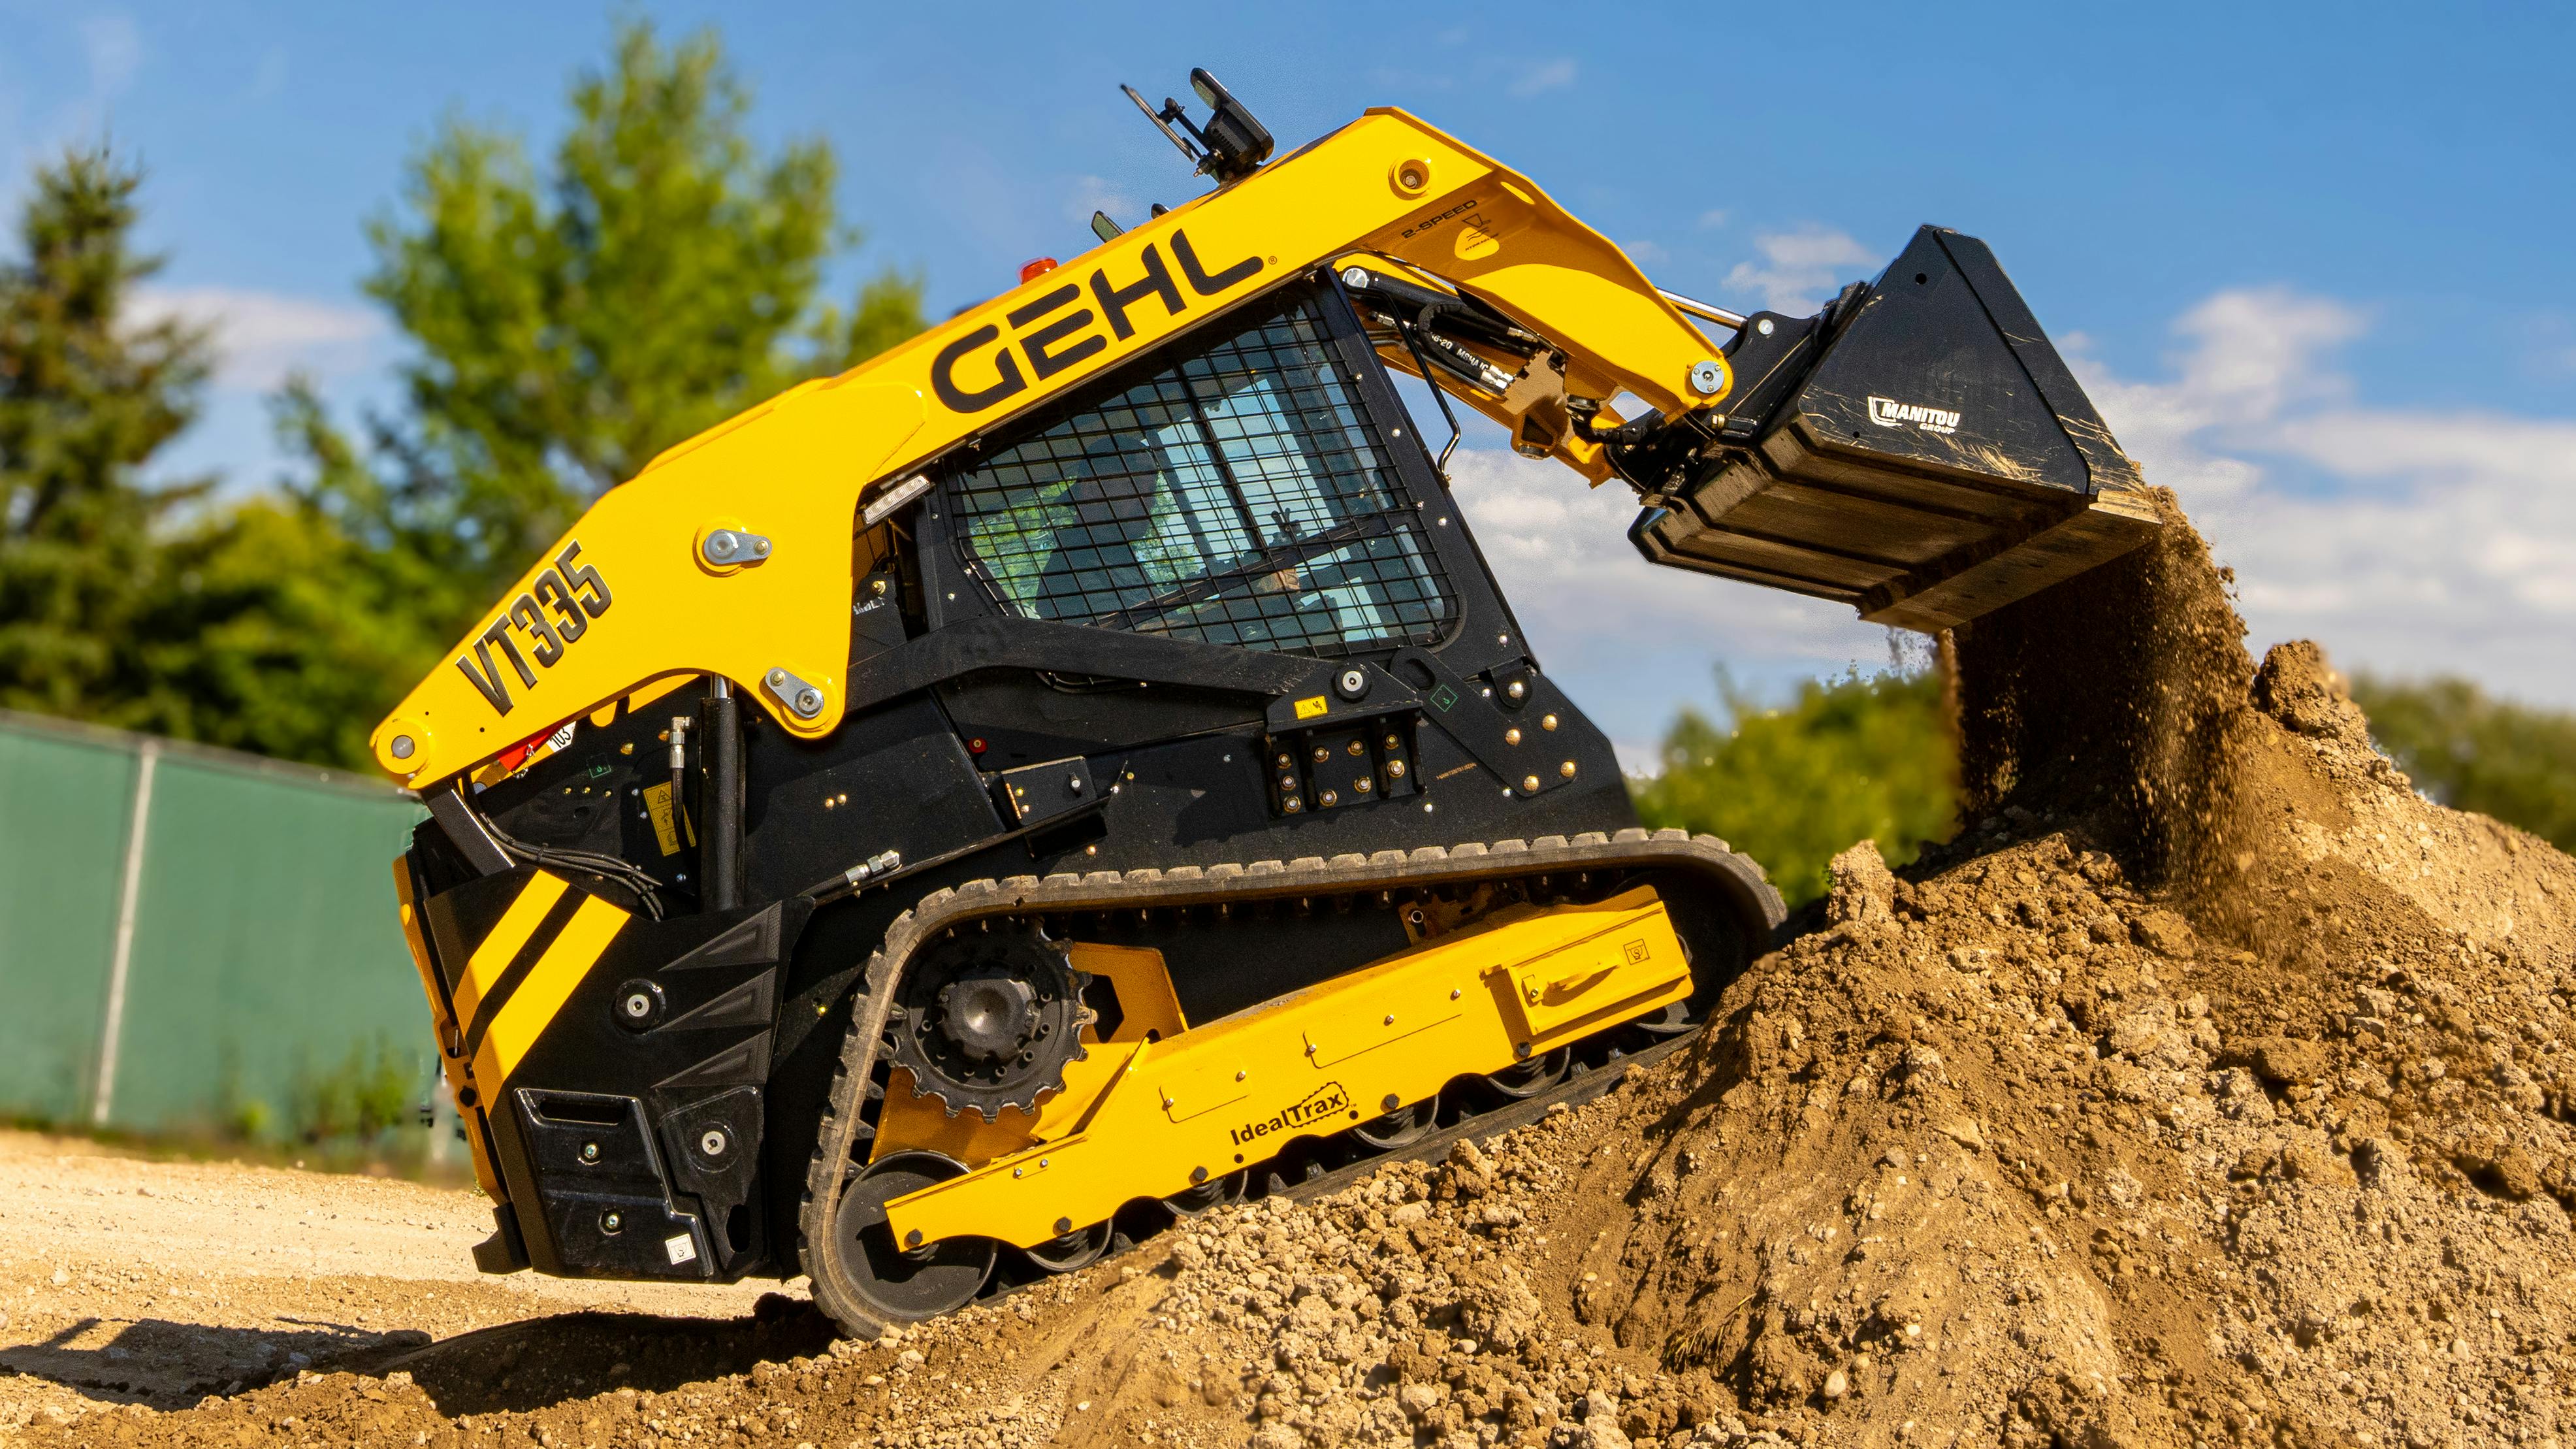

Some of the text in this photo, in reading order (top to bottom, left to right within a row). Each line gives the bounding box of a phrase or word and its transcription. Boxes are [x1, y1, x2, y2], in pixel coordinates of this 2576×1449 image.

[1402, 200, 1477, 238] 2-SPEED
[931, 229, 1264, 413] GEHL
[1881, 402, 1961, 427] MANITOU
[1919, 423, 1956, 434] GROUP
[456, 539, 613, 717] VT335
[1230, 1094, 1343, 1146] IdealTrax
